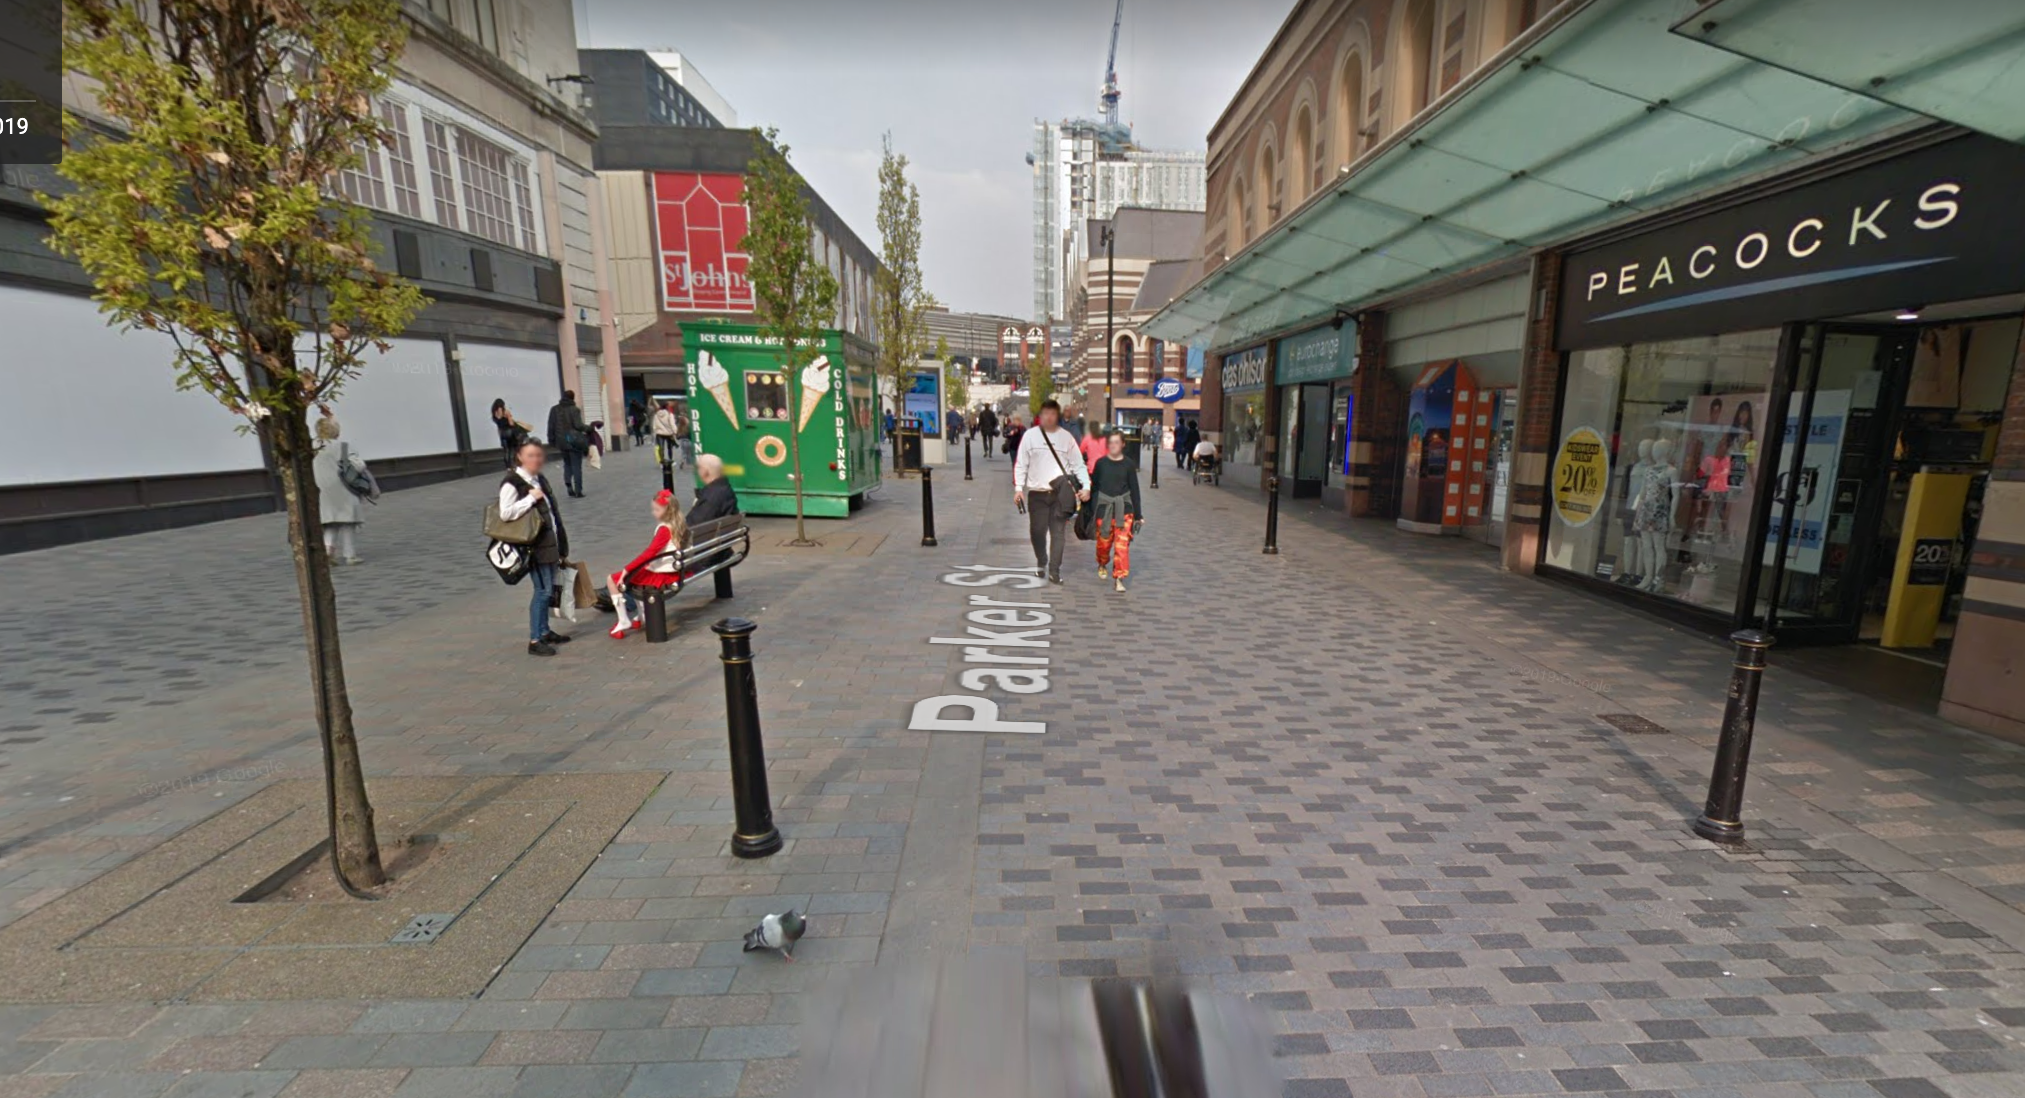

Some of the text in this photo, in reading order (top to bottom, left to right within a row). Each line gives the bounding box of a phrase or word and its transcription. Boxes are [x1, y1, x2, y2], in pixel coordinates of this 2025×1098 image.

[1587, 183, 1960, 301] PEACOCKS
[700, 333, 715, 343] ICE
[718, 334, 753, 345] CREAM
[1296, 337, 1340, 360] eurochange
[687, 363, 697, 398] HOT
[1222, 356, 1238, 389] clas
[833, 368, 847, 480] COLD DRINKS
[1568, 443, 1599, 454] KIDSWEAR
[1572, 454, 1592, 462] EVENT
[1560, 463, 1598, 495] 20%
[1584, 489, 1597, 497] OFF
